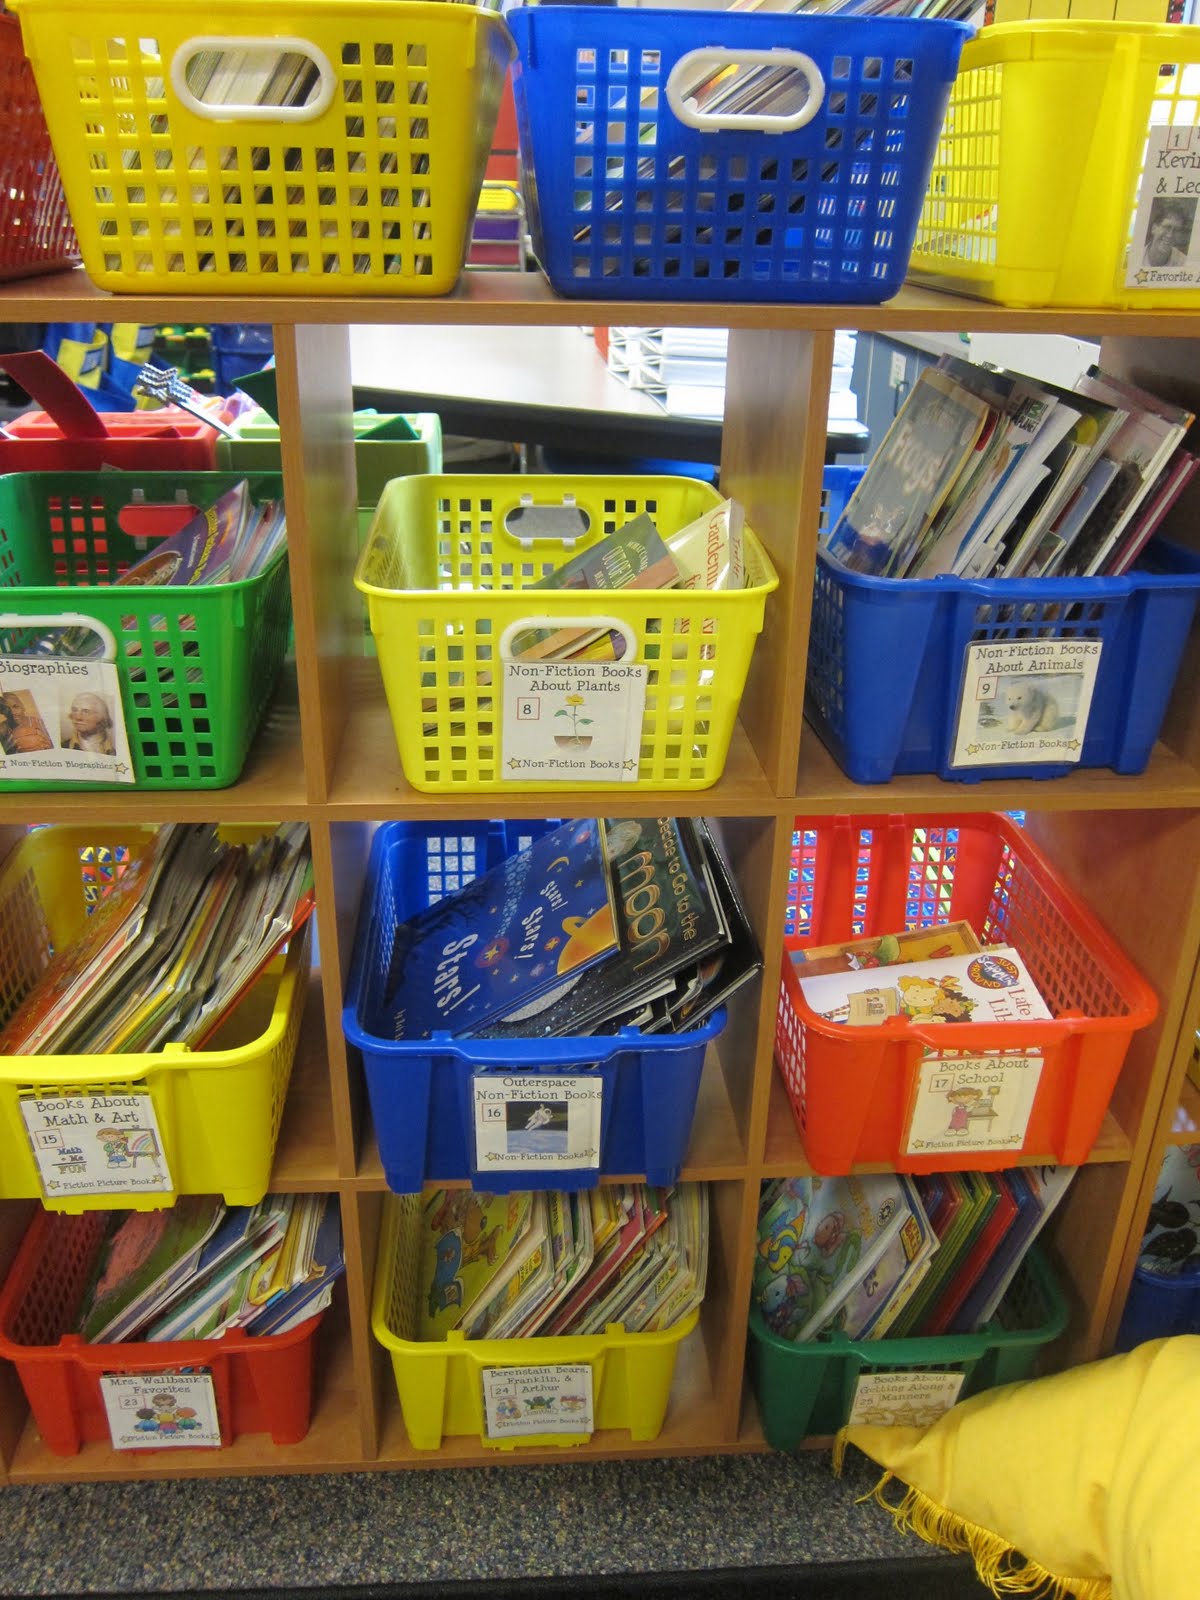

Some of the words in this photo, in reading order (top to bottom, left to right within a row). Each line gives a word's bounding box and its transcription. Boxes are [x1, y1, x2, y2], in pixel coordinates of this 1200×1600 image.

[1173, 134, 1180, 147] 1
[1156, 176, 1167, 193] &
[1150, 270, 1193, 282] Favorite
[976, 645, 1054, 660] Non-Fiction
[1060, 644, 1098, 655] Books
[509, 665, 595, 678] Non-Fiction
[601, 666, 642, 678] Books
[985, 661, 1024, 674] About
[1028, 659, 1085, 672] Animals
[529, 680, 572, 692] About
[577, 680, 621, 692] Plants
[982, 683, 990, 695] 9
[522, 704, 532, 715] 8
[976, 740, 1035, 751] Non-Fiction
[1038, 740, 1069, 749] Books
[10, 760, 62, 768] Non-Fiction
[65, 760, 113, 770] Biographies
[522, 759, 588, 769] Non-Fiction
[590, 759, 620, 769] Books
[540, 880, 569, 911] Stars!
[514, 906, 543, 960] Stars!
[996, 957, 1018, 975] JUST
[433, 933, 481, 1016] Stars!
[1008, 988, 1032, 1016] Late
[940, 1060, 981, 1072] Books
[985, 1058, 1029, 1070] About
[502, 1077, 577, 1088] Outerspace
[935, 1079, 949, 1088] 17
[956, 1072, 1005, 1085] School
[477, 1090, 559, 1100] Non-Fiction
[564, 1090, 603, 1100] Books
[34, 1098, 84, 1113] Books
[91, 1096, 140, 1109] About
[43, 1112, 89, 1127] Math
[94, 1113, 106, 1123] &
[112, 1110, 140, 1124] Art
[488, 1108, 501, 1118] 16
[42, 1134, 57, 1145] 15
[925, 1141, 954, 1149] Fiction
[57, 1147, 82, 1155] Math
[496, 1152, 554, 1161] Non-Fiction
[557, 1152, 584, 1160] Books
[58, 1164, 87, 1175] FUN
[63, 1179, 95, 1190] Fiction
[97, 1179, 128, 1188] Picture
[130, 1178, 155, 1186] Books
[490, 1368, 551, 1378] Berenstain
[110, 1378, 138, 1386] Mrs.
[507, 1376, 560, 1385] Franklin,
[873, 1375, 908, 1384] Books
[132, 1386, 191, 1394] Favorites
[495, 1387, 509, 1395] 24
[521, 1385, 560, 1394] Arthur
[860, 1384, 904, 1394] Getting
[907, 1383, 943, 1392] Along
[124, 1399, 138, 1407] 23
[880, 1393, 931, 1402] Manners
